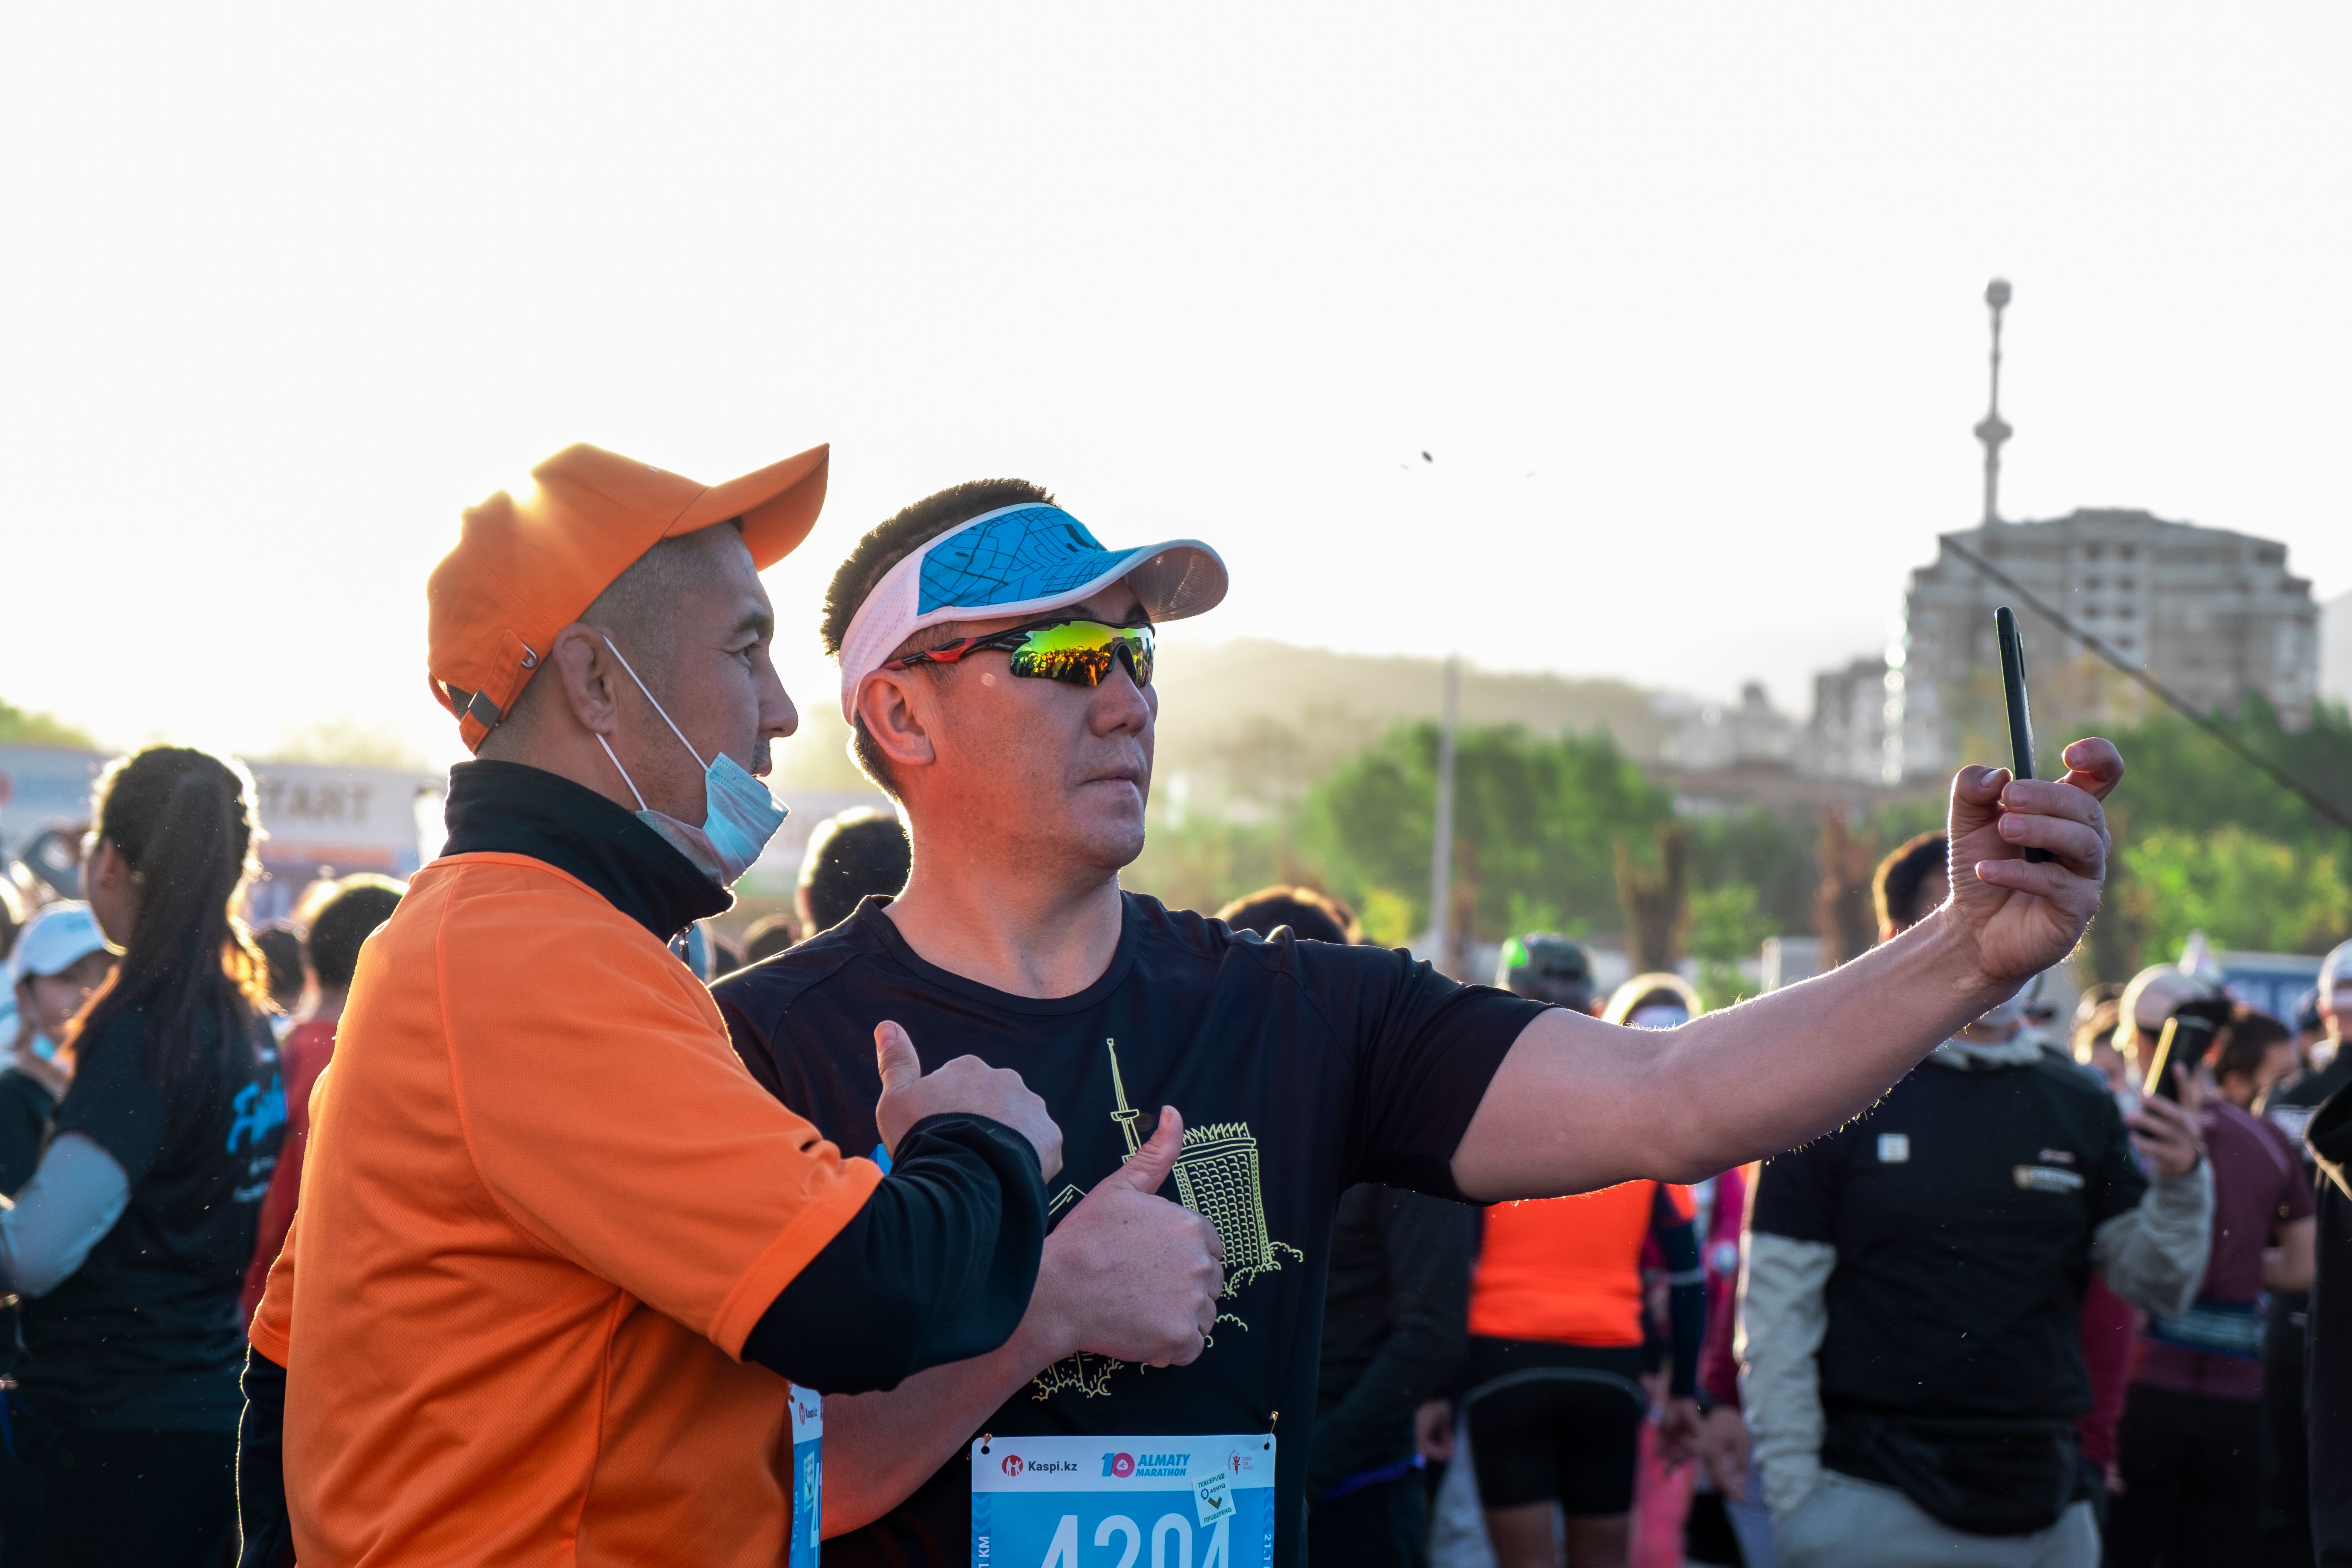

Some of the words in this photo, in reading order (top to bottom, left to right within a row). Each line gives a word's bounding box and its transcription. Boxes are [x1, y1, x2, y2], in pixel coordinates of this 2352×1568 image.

[262, 779, 376, 825] TART
[1028, 1461, 1077, 1474] Kaspi.kz
[1138, 1454, 1191, 1466] ALMATY
[1135, 1468, 1187, 1477] MARATHON
[1198, 1473, 1225, 1488] ТЕКСЕРІЛДІ
[1210, 1484, 1226, 1493] ASHYQ
[1204, 1508, 1232, 1523] ПРОВЕРЕНО
[978, 1536, 989, 1557] KM
[1263, 1533, 1272, 1560] 21.1
